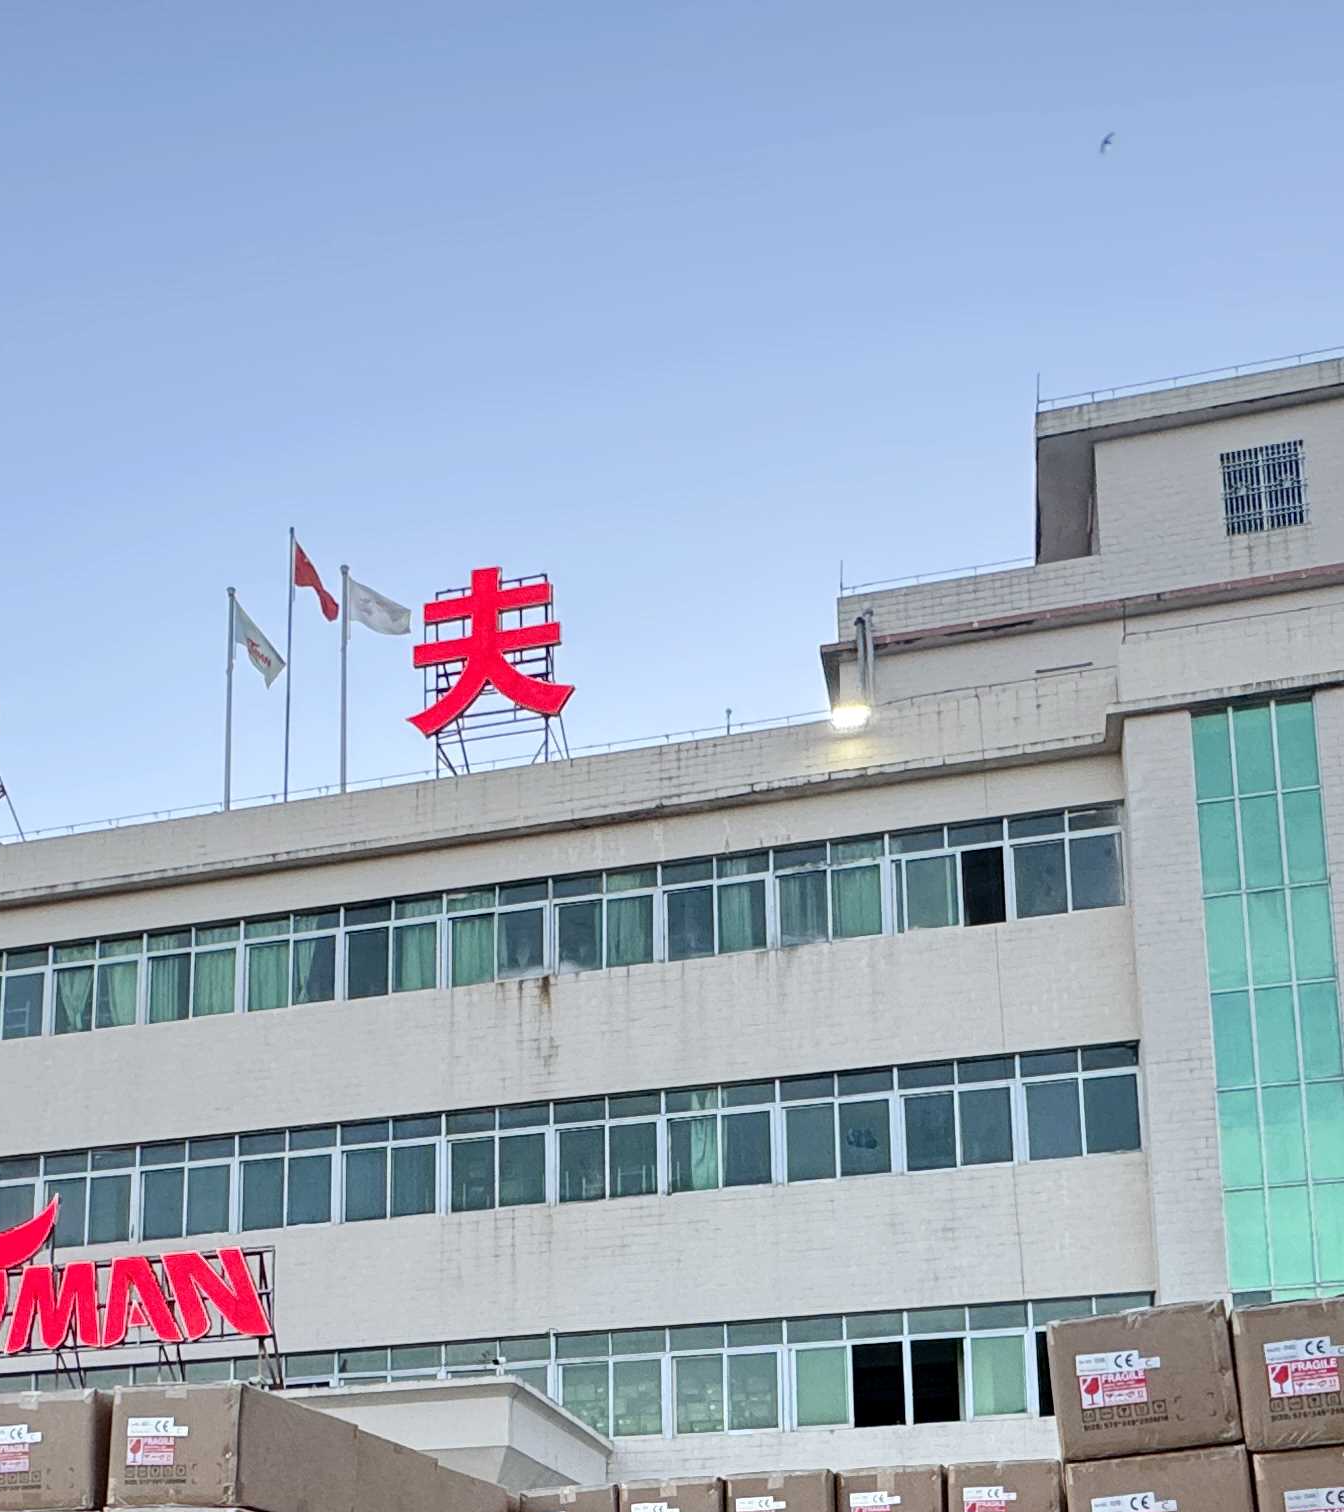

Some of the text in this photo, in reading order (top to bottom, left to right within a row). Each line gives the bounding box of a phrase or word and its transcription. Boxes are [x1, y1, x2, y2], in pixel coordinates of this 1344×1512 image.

[1306, 1340, 1325, 1355] CE
[1114, 1354, 1132, 1368] CE
[1291, 1357, 1336, 1371] FRAGILE
[1101, 1369, 1145, 1383] FRAGILE
[1131, 1494, 1150, 1512] CE
